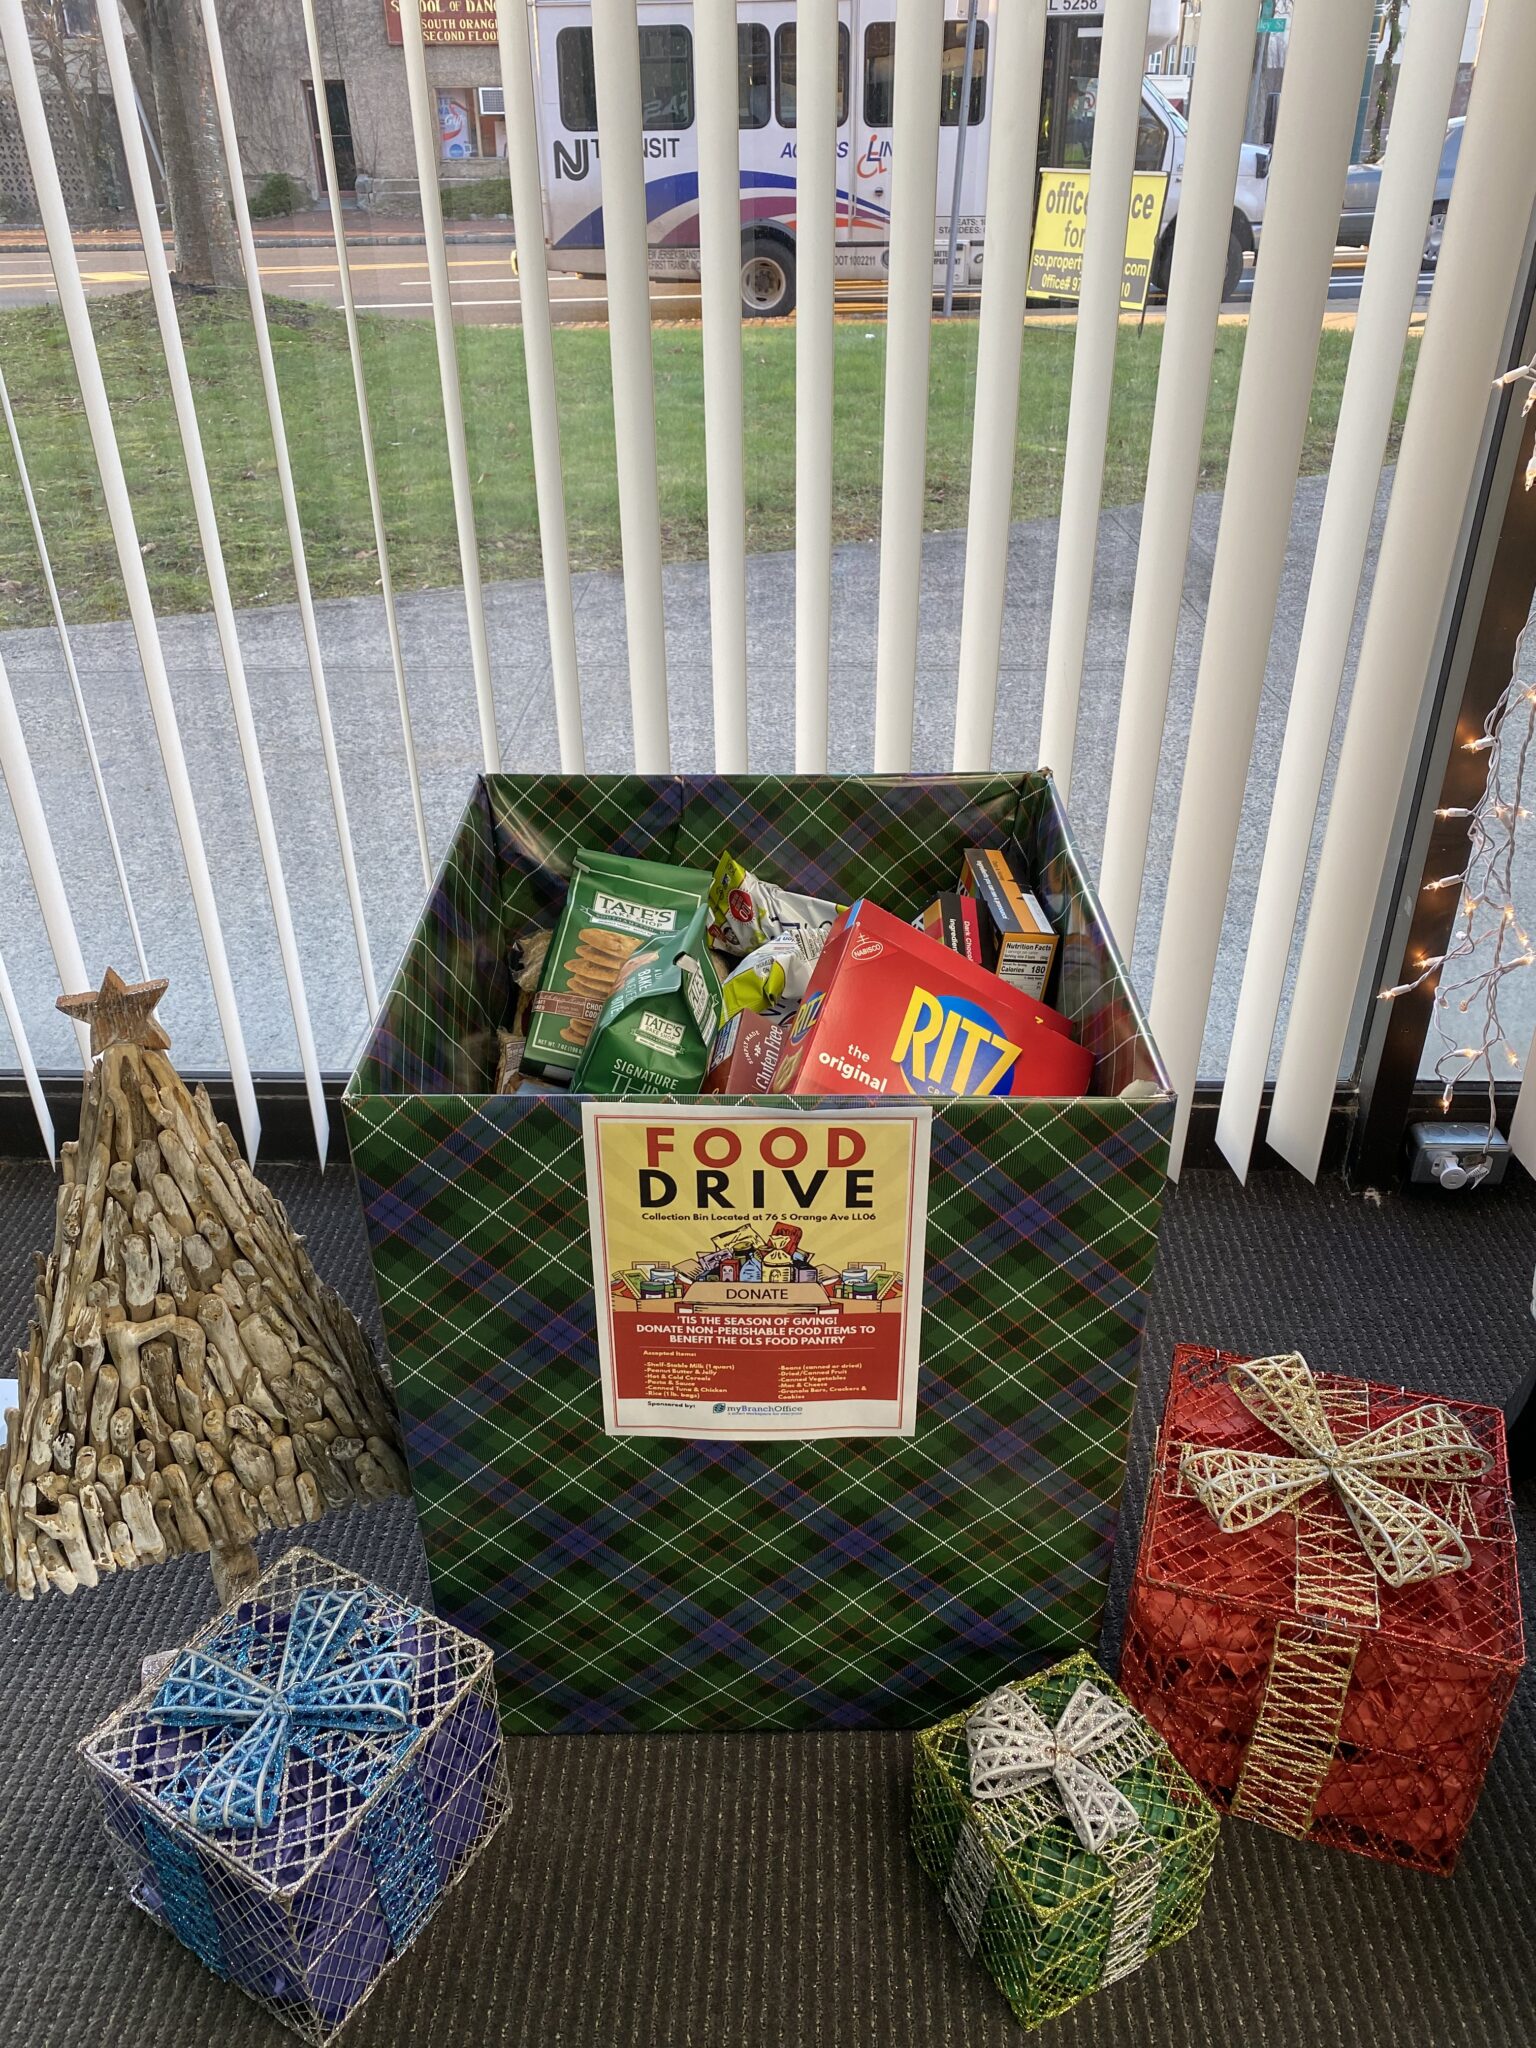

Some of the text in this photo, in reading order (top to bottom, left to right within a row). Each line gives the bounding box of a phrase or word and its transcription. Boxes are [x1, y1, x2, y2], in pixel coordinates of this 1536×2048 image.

[1063, 0, 1098, 10] 5258
[421, 18, 456, 29] SOUTH
[423, 30, 500, 41] SECOND FLOO
[600, 896, 672, 923] TATE'S
[604, 909, 664, 928] BAKE SHOP
[854, 943, 882, 958] NABISCO
[1032, 966, 1046, 974] 180
[644, 1014, 682, 1038] TATE'S
[646, 1026, 659, 1036] BAKE
[764, 1024, 784, 1052] Free
[891, 985, 1023, 1095] RITZ
[848, 1044, 870, 1063] the
[614, 1058, 679, 1090] SIGNATURE
[756, 1050, 778, 1090] Gluten
[818, 1052, 888, 1094] original
[646, 1126, 866, 1168] FOOD
[638, 1168, 874, 1209] DRIVE
[642, 1212, 690, 1220] Collection
[790, 1214, 828, 1222] Orange
[726, 1288, 788, 1300] DONATE
[700, 1316, 720, 1325] THE
[724, 1317, 772, 1326] SEASON
[774, 1317, 790, 1326] OF
[792, 1316, 838, 1326] GIVING!
[636, 1324, 876, 1336] DONATE NON-PERISHABLE FOOD ITEMS TO
[670, 1335, 846, 1345] BENEFIT THE OLS FOOD PANTRY
[727, 1405, 804, 1414] myBranchOffice
